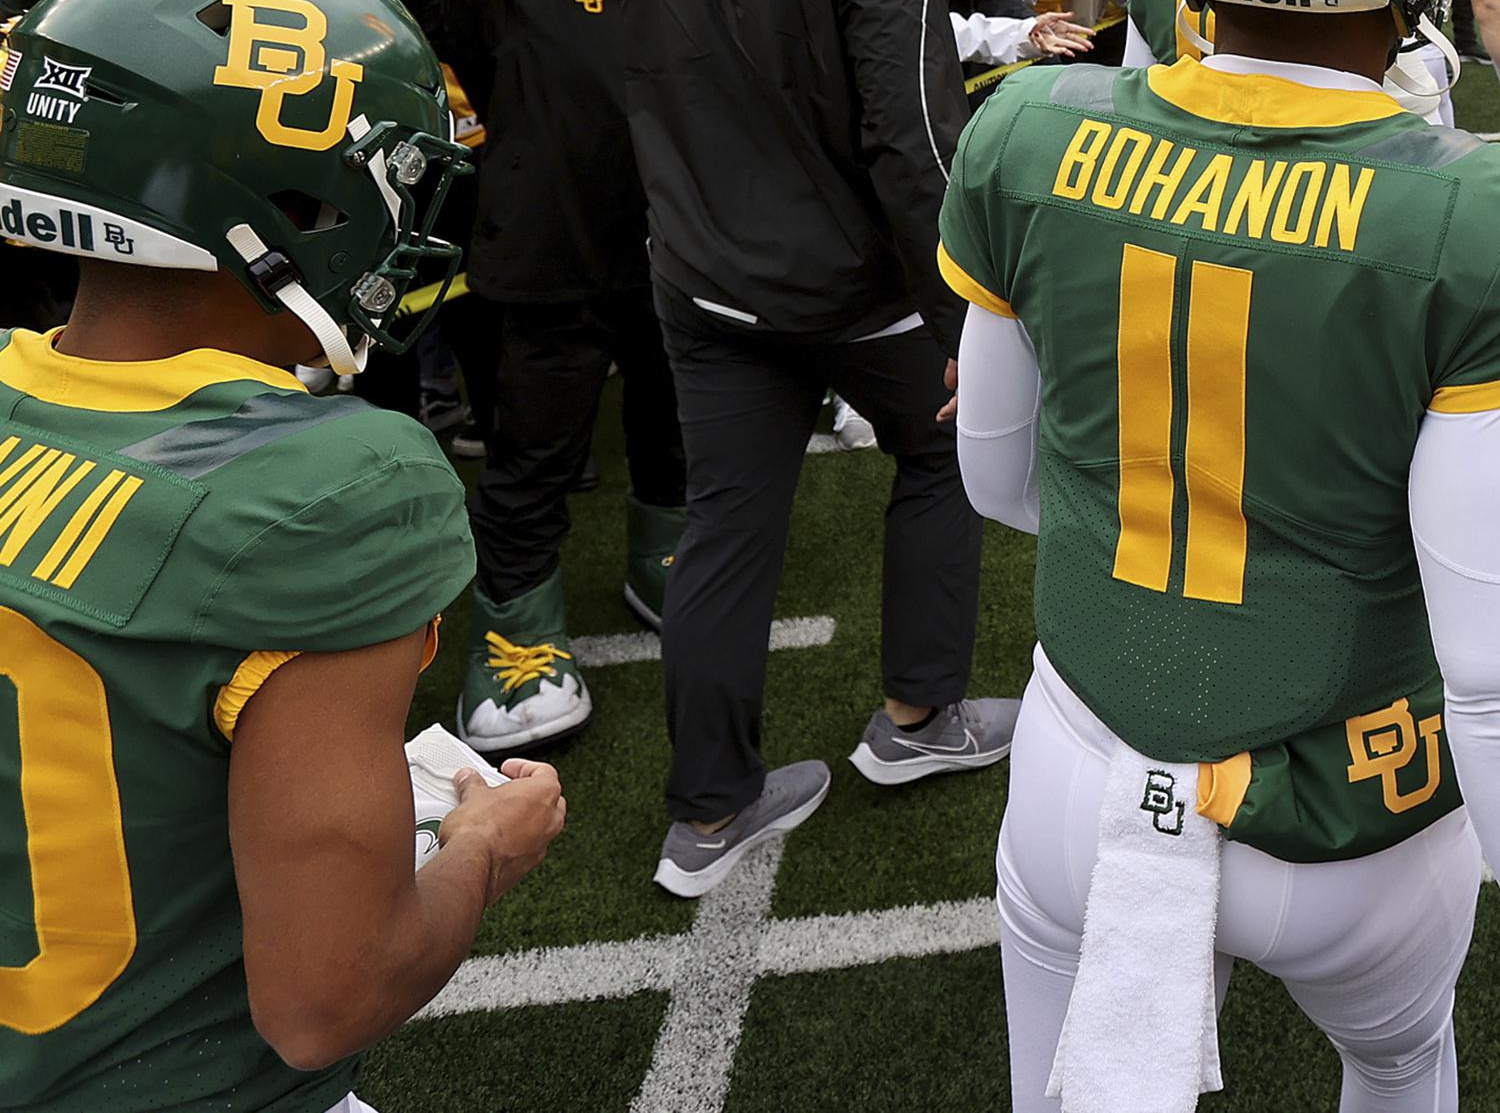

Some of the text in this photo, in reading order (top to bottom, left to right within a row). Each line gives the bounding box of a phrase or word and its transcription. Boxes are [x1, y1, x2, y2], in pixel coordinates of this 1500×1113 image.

[26, 91, 82, 124] UNITY
[0, 198, 95, 253] dell
[1051, 117, 1376, 253] BOHANON
[1112, 243, 1254, 606] 11
[31, 468, 145, 590] II
